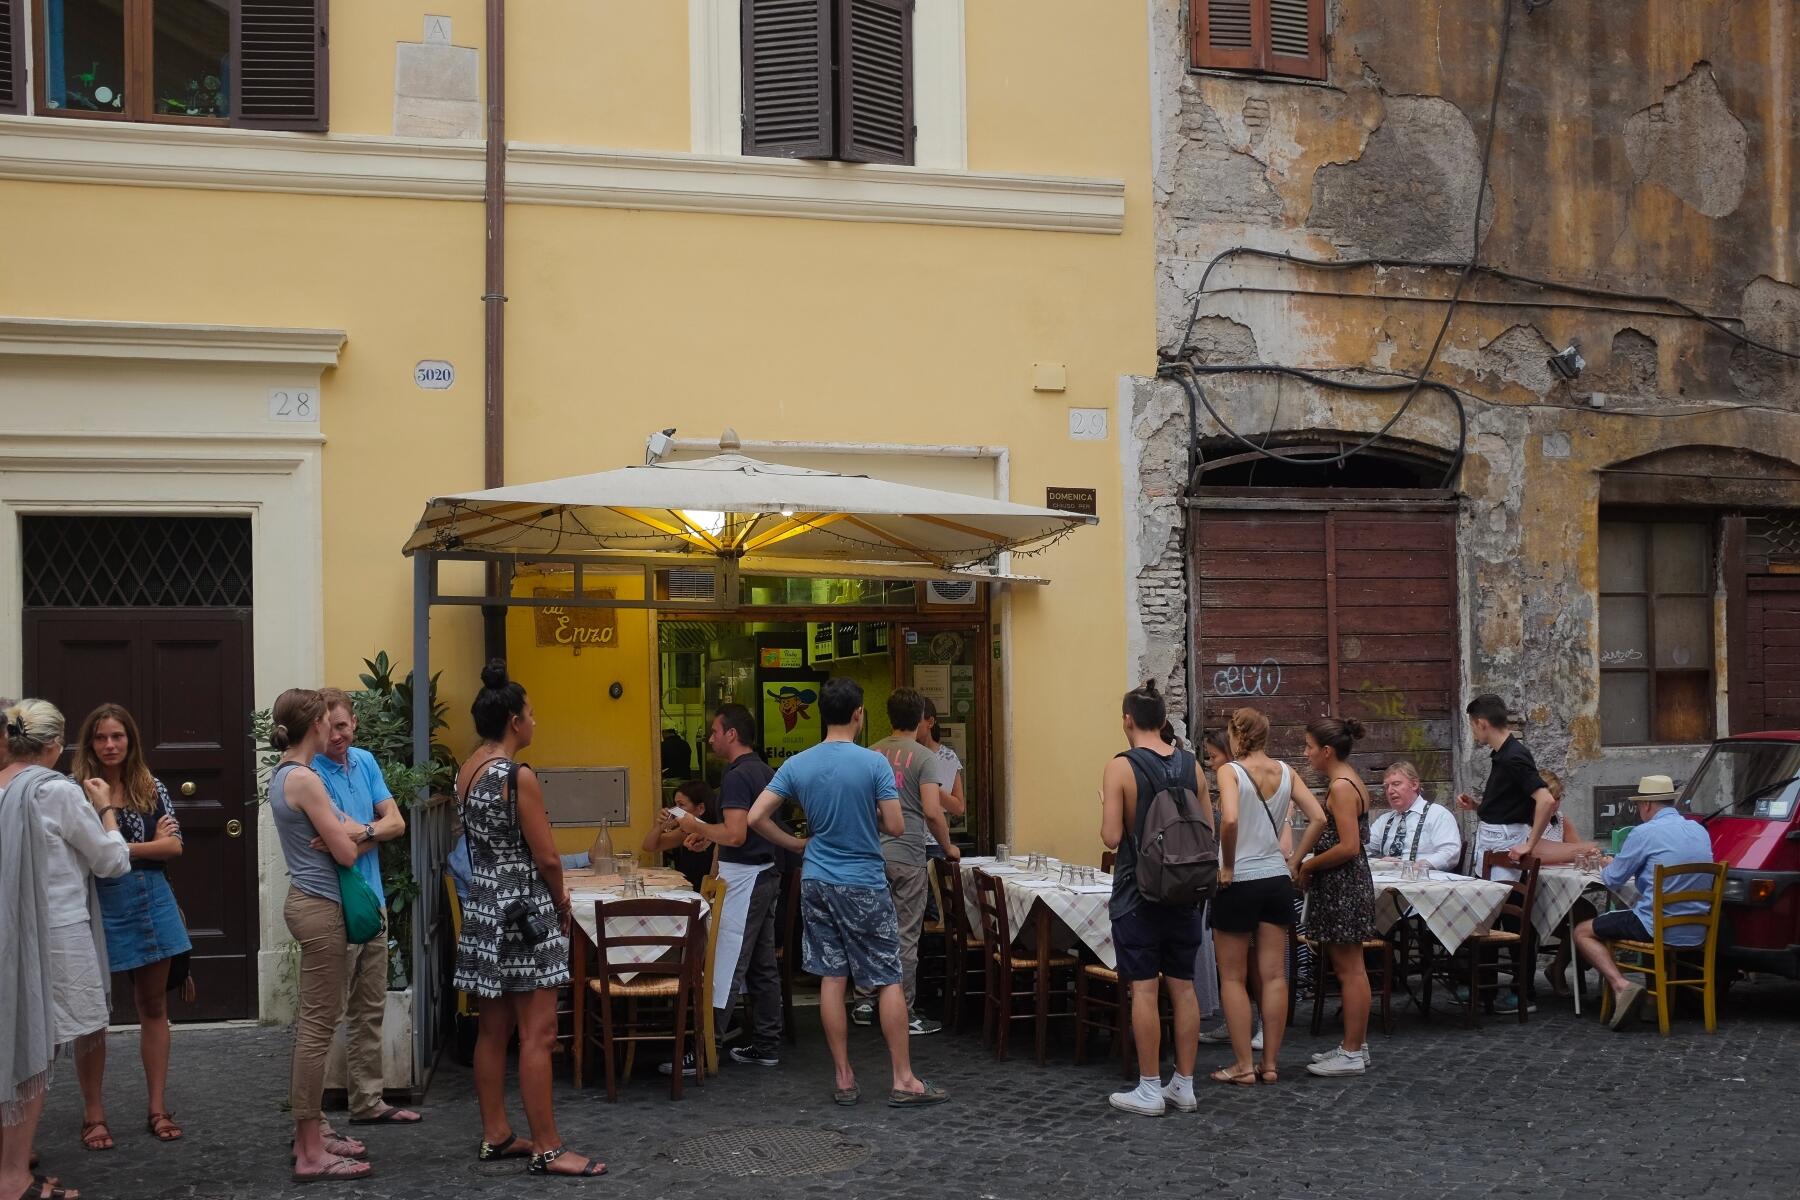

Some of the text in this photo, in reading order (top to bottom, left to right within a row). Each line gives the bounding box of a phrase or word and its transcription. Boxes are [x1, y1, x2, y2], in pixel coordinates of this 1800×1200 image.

[429, 18, 447, 39] A
[417, 368, 451, 381] 3020
[273, 391, 310, 416] 28
[1072, 412, 1104, 435] 29
[1049, 492, 1093, 501] DOMENICA
[555, 615, 614, 643] Enzo
